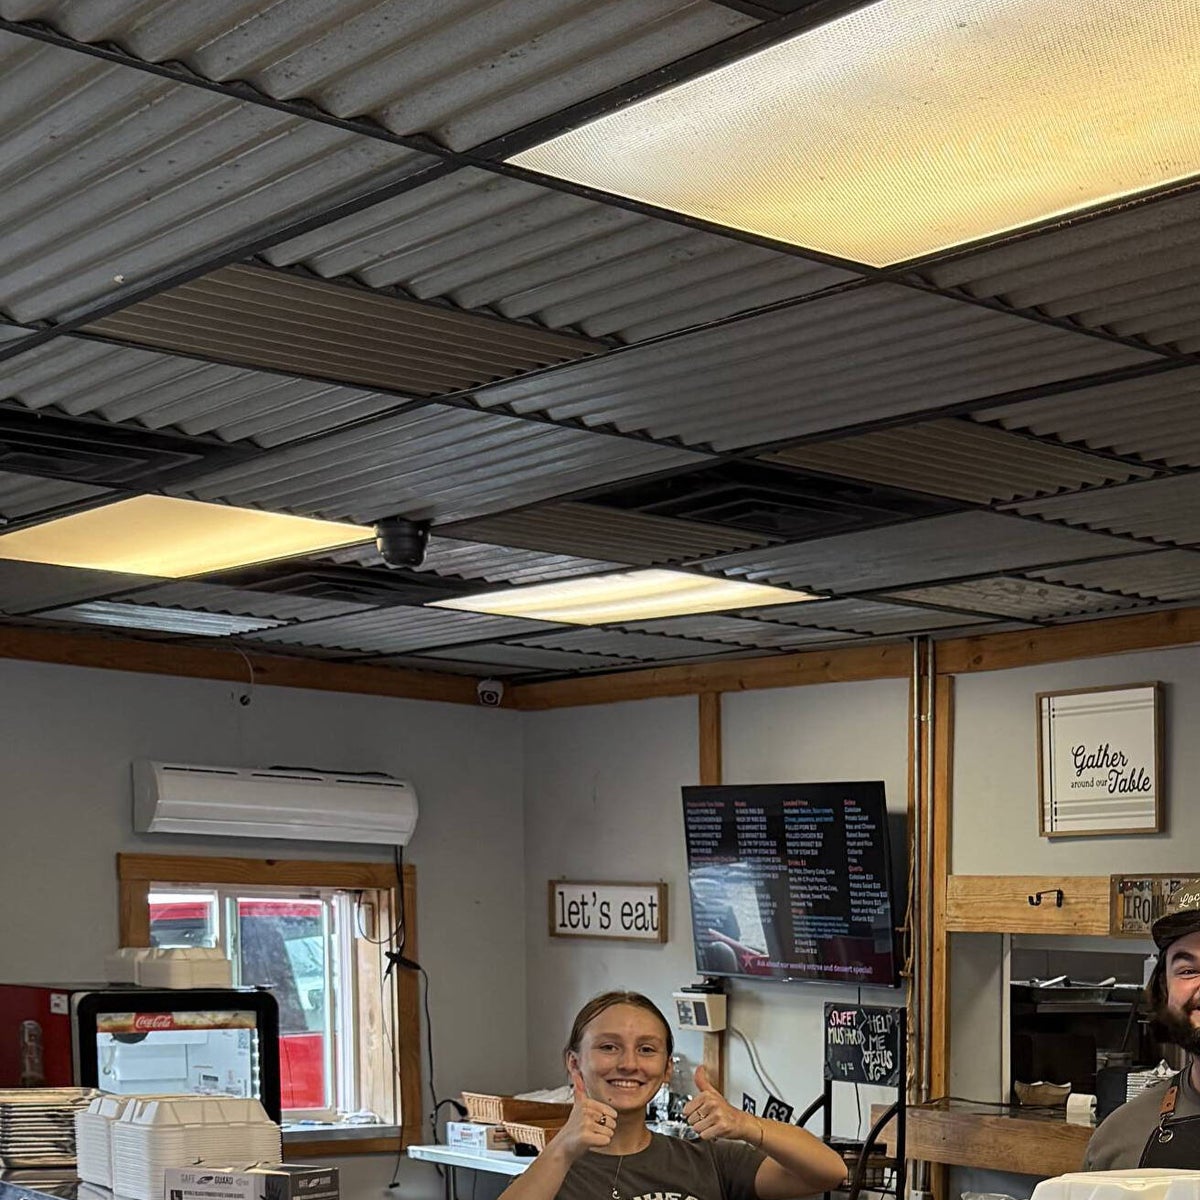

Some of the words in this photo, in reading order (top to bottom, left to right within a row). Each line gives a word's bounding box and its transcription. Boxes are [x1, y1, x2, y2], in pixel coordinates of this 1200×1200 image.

[1071, 743, 1128, 777] Gather
[1071, 778, 1094, 788] around
[1096, 780, 1108, 788] our
[1108, 767, 1152, 794] Table
[558, 891, 611, 930] let's
[620, 895, 659, 931] eat
[830, 1010, 857, 1026] SWEET
[867, 1014, 892, 1034] HELP
[868, 1034, 886, 1051] ME
[864, 1050, 892, 1069] JESUS
